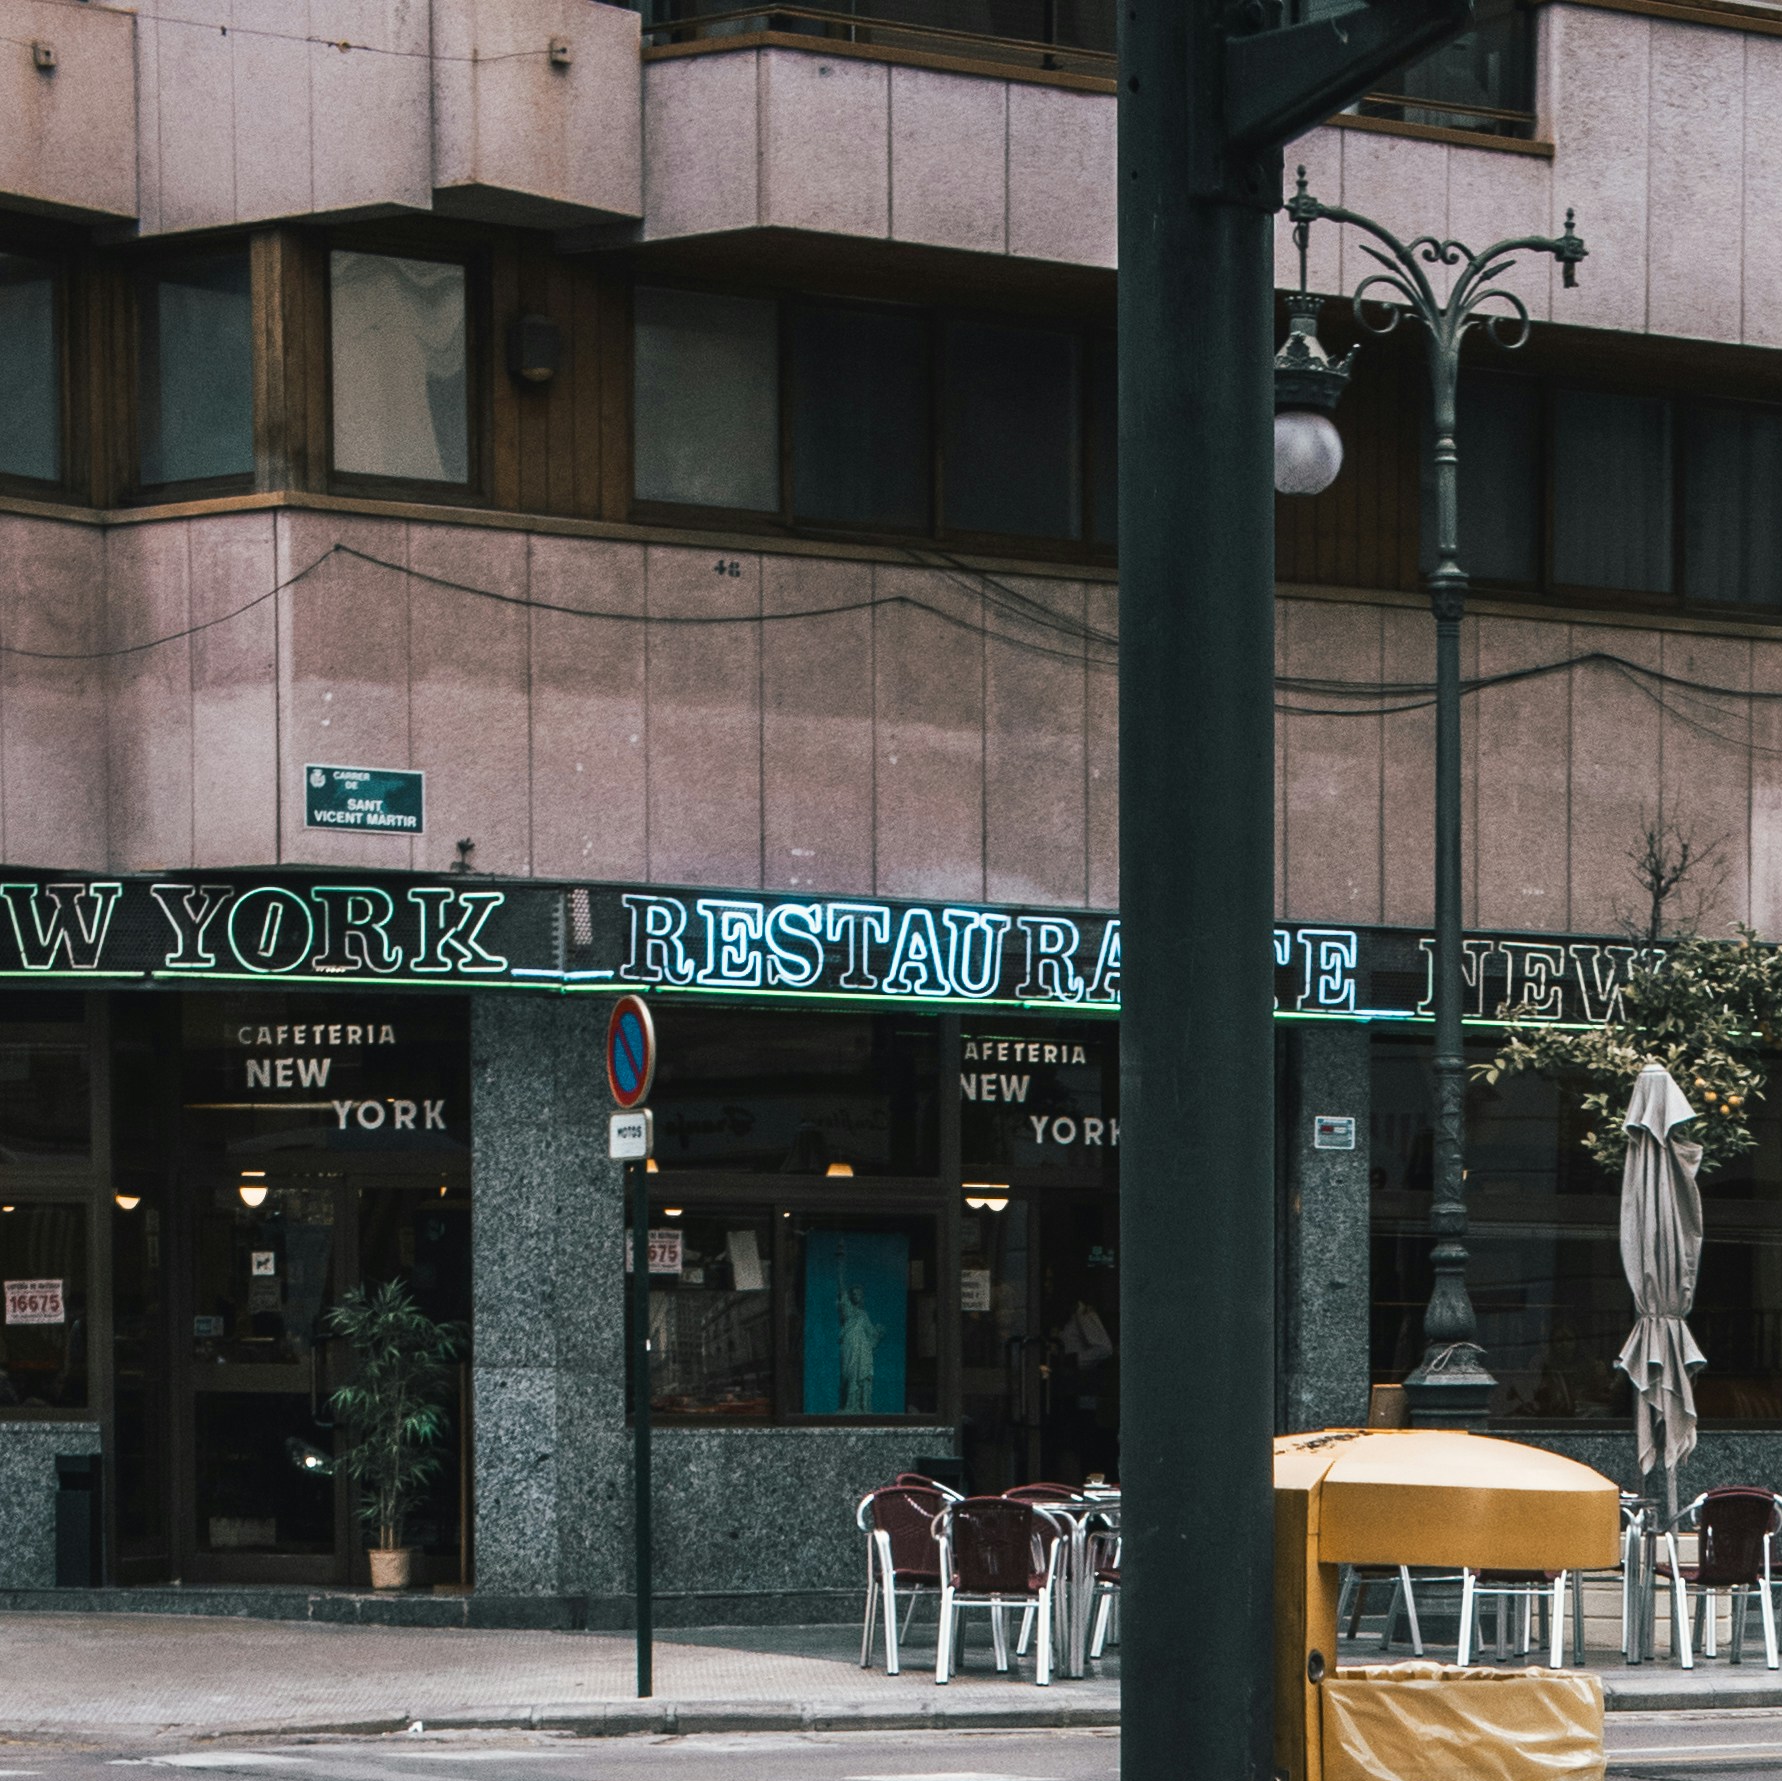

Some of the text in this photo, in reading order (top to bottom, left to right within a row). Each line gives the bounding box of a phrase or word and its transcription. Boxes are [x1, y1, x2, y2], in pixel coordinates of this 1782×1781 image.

[332, 771, 371, 781] CARRER
[344, 781, 359, 790] DE
[346, 798, 384, 812] SANT
[313, 809, 364, 825] VICENT
[151, 884, 508, 974] YORK
[237, 1023, 396, 1046] CAFETERIA
[963, 1041, 1088, 1065] AFETERIA
[246, 1056, 331, 1089] NEW
[960, 1072, 1031, 1103] NEW
[331, 1098, 448, 1130] YORK
[616, 1125, 642, 1139] MOTOS
[648, 1243, 679, 1263] 675
[9, 1293, 61, 1314] 16675
